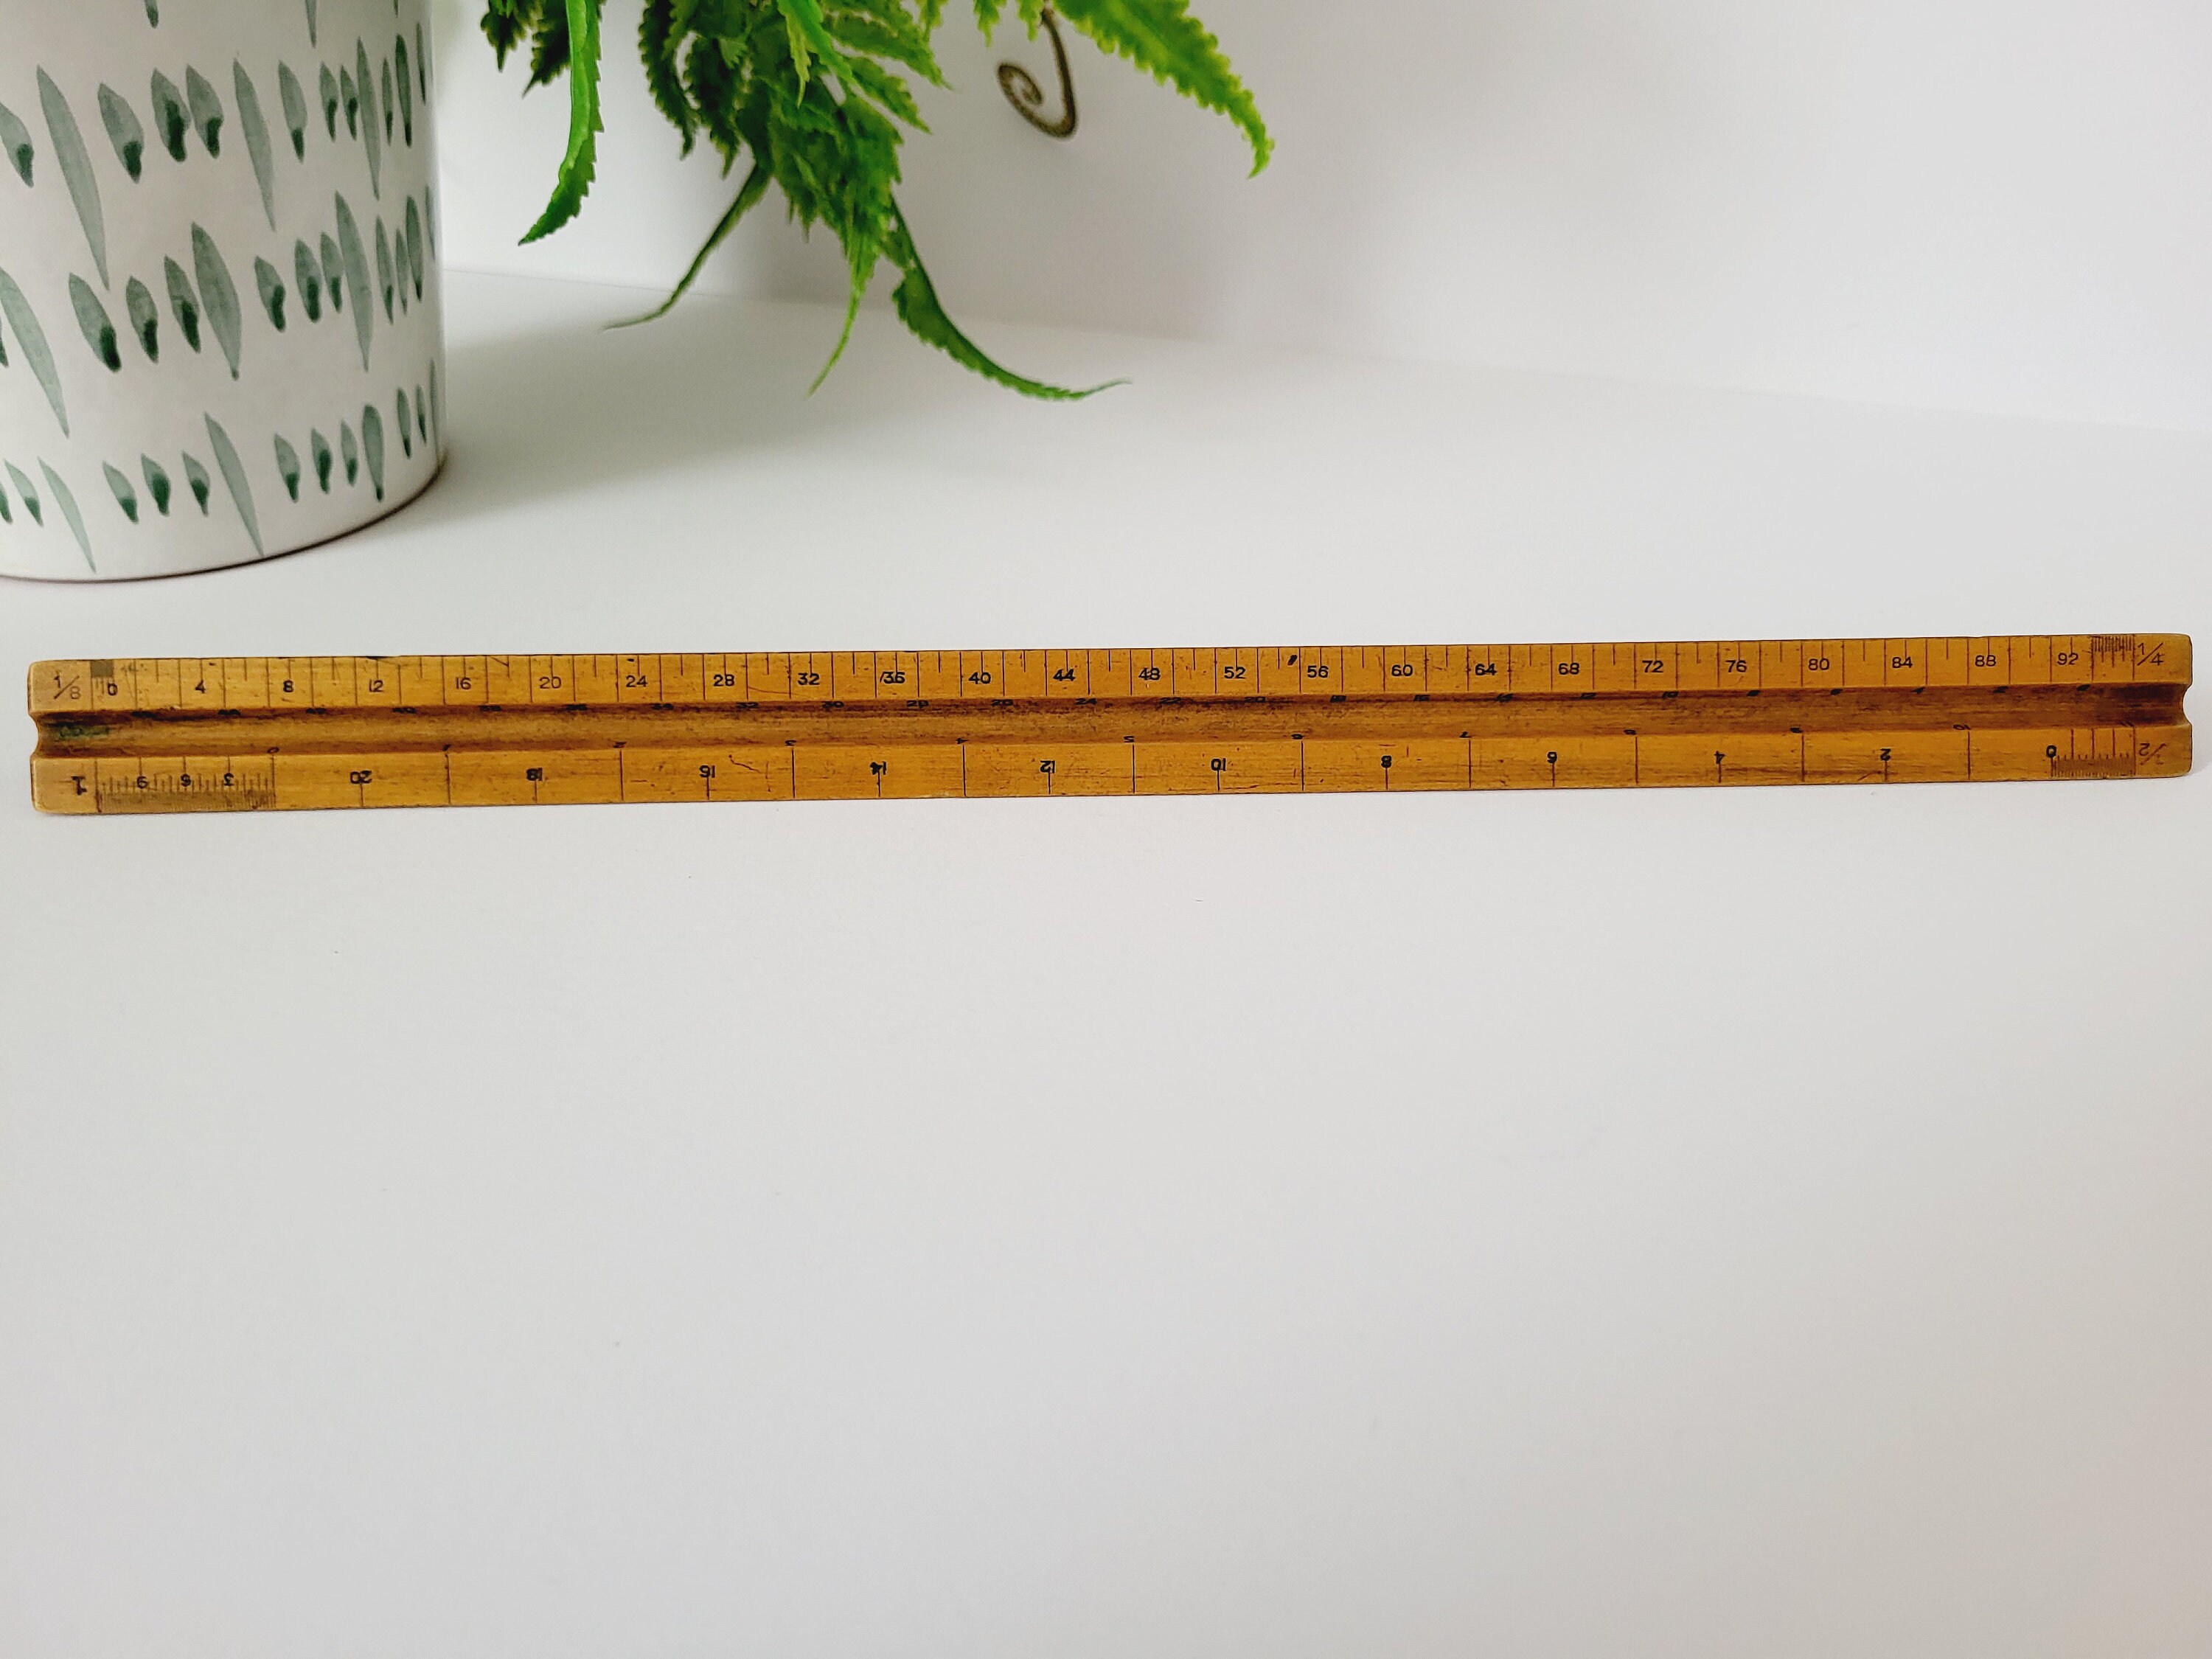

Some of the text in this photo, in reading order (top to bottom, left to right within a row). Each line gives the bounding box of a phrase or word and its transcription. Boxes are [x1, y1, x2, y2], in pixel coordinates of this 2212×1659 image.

[107, 683, 118, 695] 0
[195, 681, 206, 693] 4
[283, 681, 294, 693] 8
[369, 680, 384, 692] 12
[455, 677, 471, 690] 16
[539, 677, 561, 689] 20
[626, 675, 647, 688] 24
[713, 675, 735, 687] 28
[798, 672, 821, 686] 32
[883, 671, 905, 684] 36
[968, 672, 991, 684] 40
[1053, 669, 1076, 681] 44
[1138, 668, 1161, 681] 48
[1223, 667, 1246, 679] 52
[1307, 666, 1329, 678] 56
[1391, 664, 1413, 677] 60
[1475, 664, 1497, 676] 64
[1558, 663, 1580, 675] 68
[1642, 661, 1664, 673] 72
[1726, 660, 1747, 672] 76
[1809, 658, 1829, 670] 80
[1892, 656, 1913, 669] 84
[1975, 655, 1996, 667] 88
[2058, 653, 2079, 665] 92
